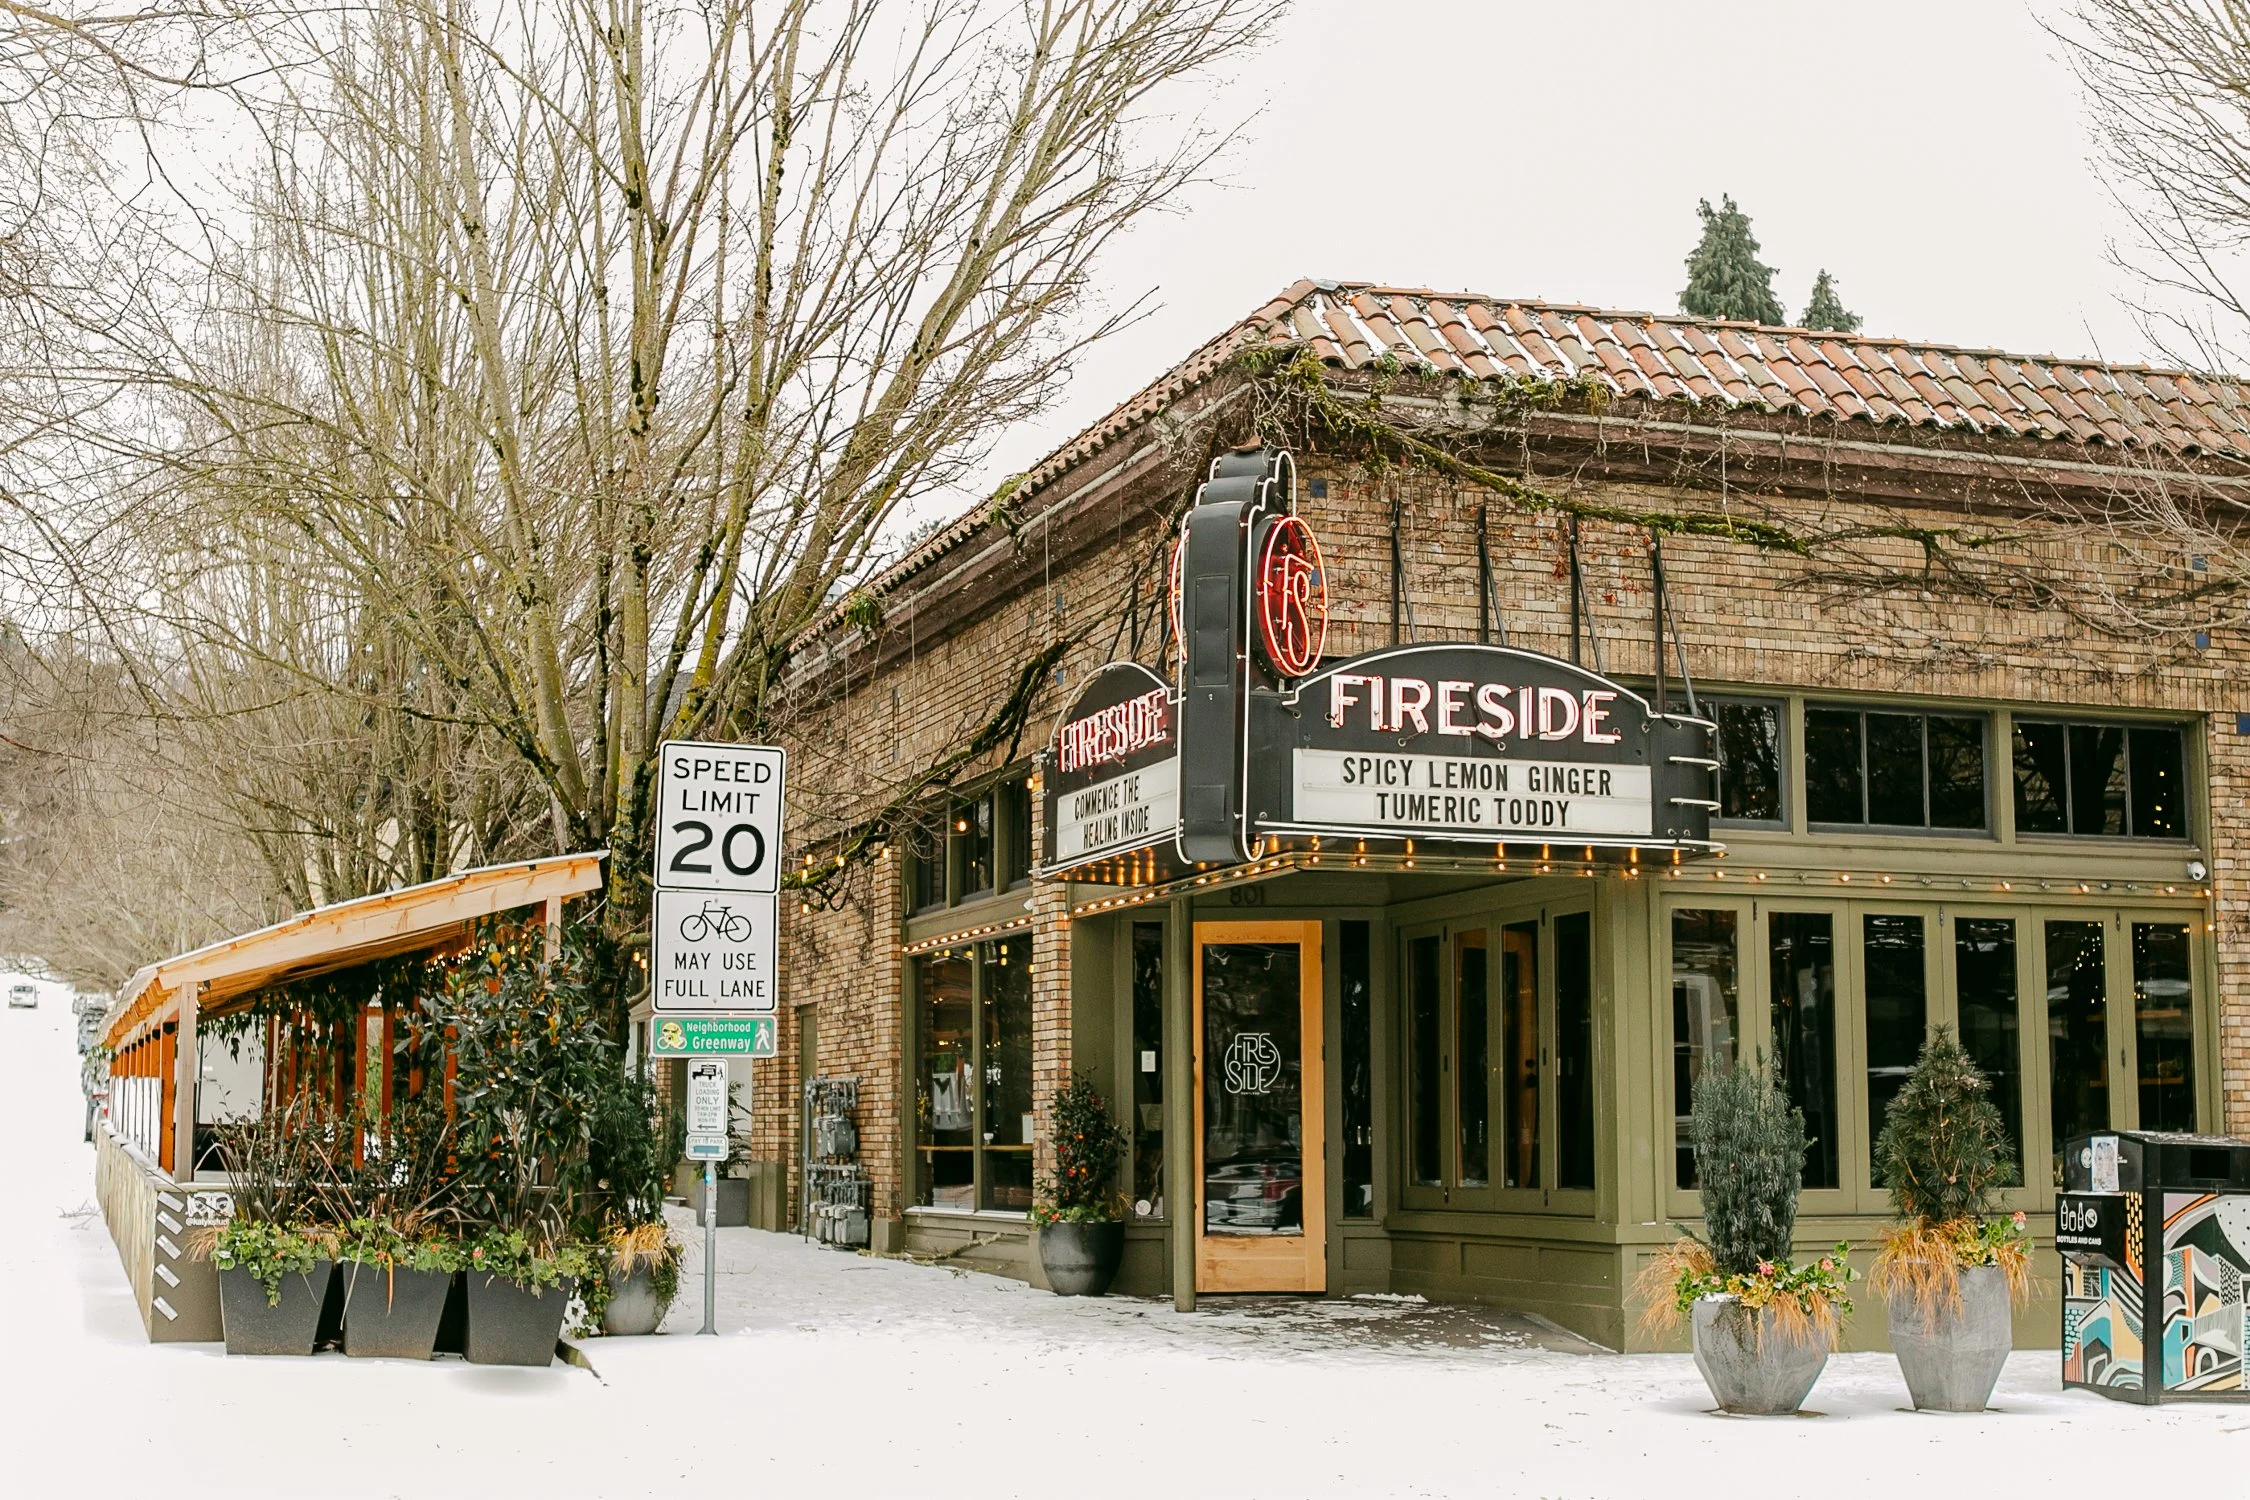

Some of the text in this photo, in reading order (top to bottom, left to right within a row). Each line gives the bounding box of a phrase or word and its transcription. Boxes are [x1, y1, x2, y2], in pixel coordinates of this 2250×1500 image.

[1330, 674, 1622, 745] FIRESIDE
[1060, 688, 1167, 773] FIRESIDE
[673, 757, 772, 784] SPEED
[1342, 757, 1612, 797] SPICY LEMON GINGER
[681, 789, 761, 814] LIMIT
[1075, 775, 1140, 820] COMMENCE THE
[1377, 792, 1570, 828] TUMERIC TODDY
[1083, 805, 1149, 850] HEALING INSIDE
[669, 820, 766, 876] 20
[1229, 884, 1265, 905] 801
[674, 952, 756, 971] MAY USE
[665, 979, 766, 998] FULL LANE
[686, 1022, 751, 1053] Neighborhood Greenway
[1234, 1032, 1277, 1065] FIRE
[695, 1088, 720, 1096] LOADING
[1224, 1060, 1271, 1094] SIDE
[695, 1096, 719, 1105] ONLY
[2056, 1235, 2102, 1246] BOTTLES AND CANS
